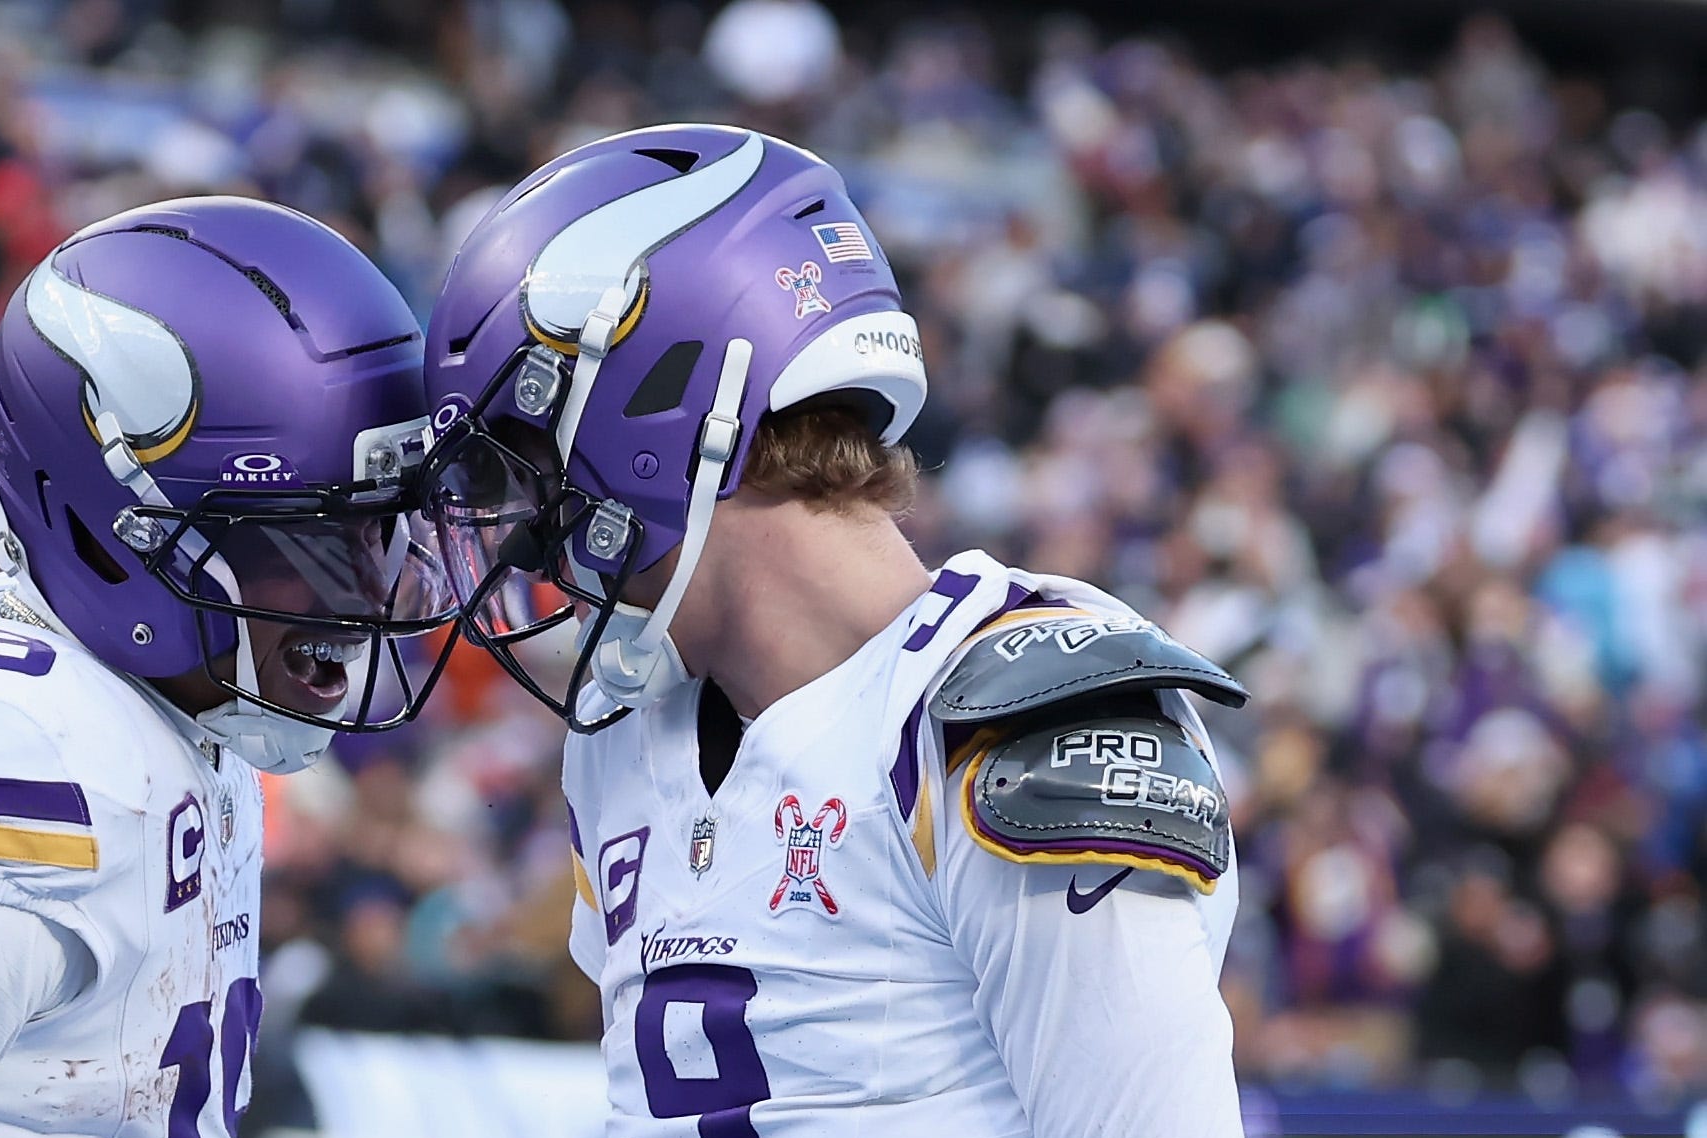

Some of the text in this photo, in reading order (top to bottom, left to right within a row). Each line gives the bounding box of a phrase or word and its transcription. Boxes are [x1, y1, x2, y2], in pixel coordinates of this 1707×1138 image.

[855, 331, 924, 362] CHOOS
[222, 473, 292, 481] OAKLEY
[1050, 729, 1162, 768] PRO
[1101, 763, 1220, 832] GEAR
[172, 804, 205, 883] C
[600, 836, 641, 914] C
[788, 849, 816, 877] NFL
[789, 891, 811, 902] 2025
